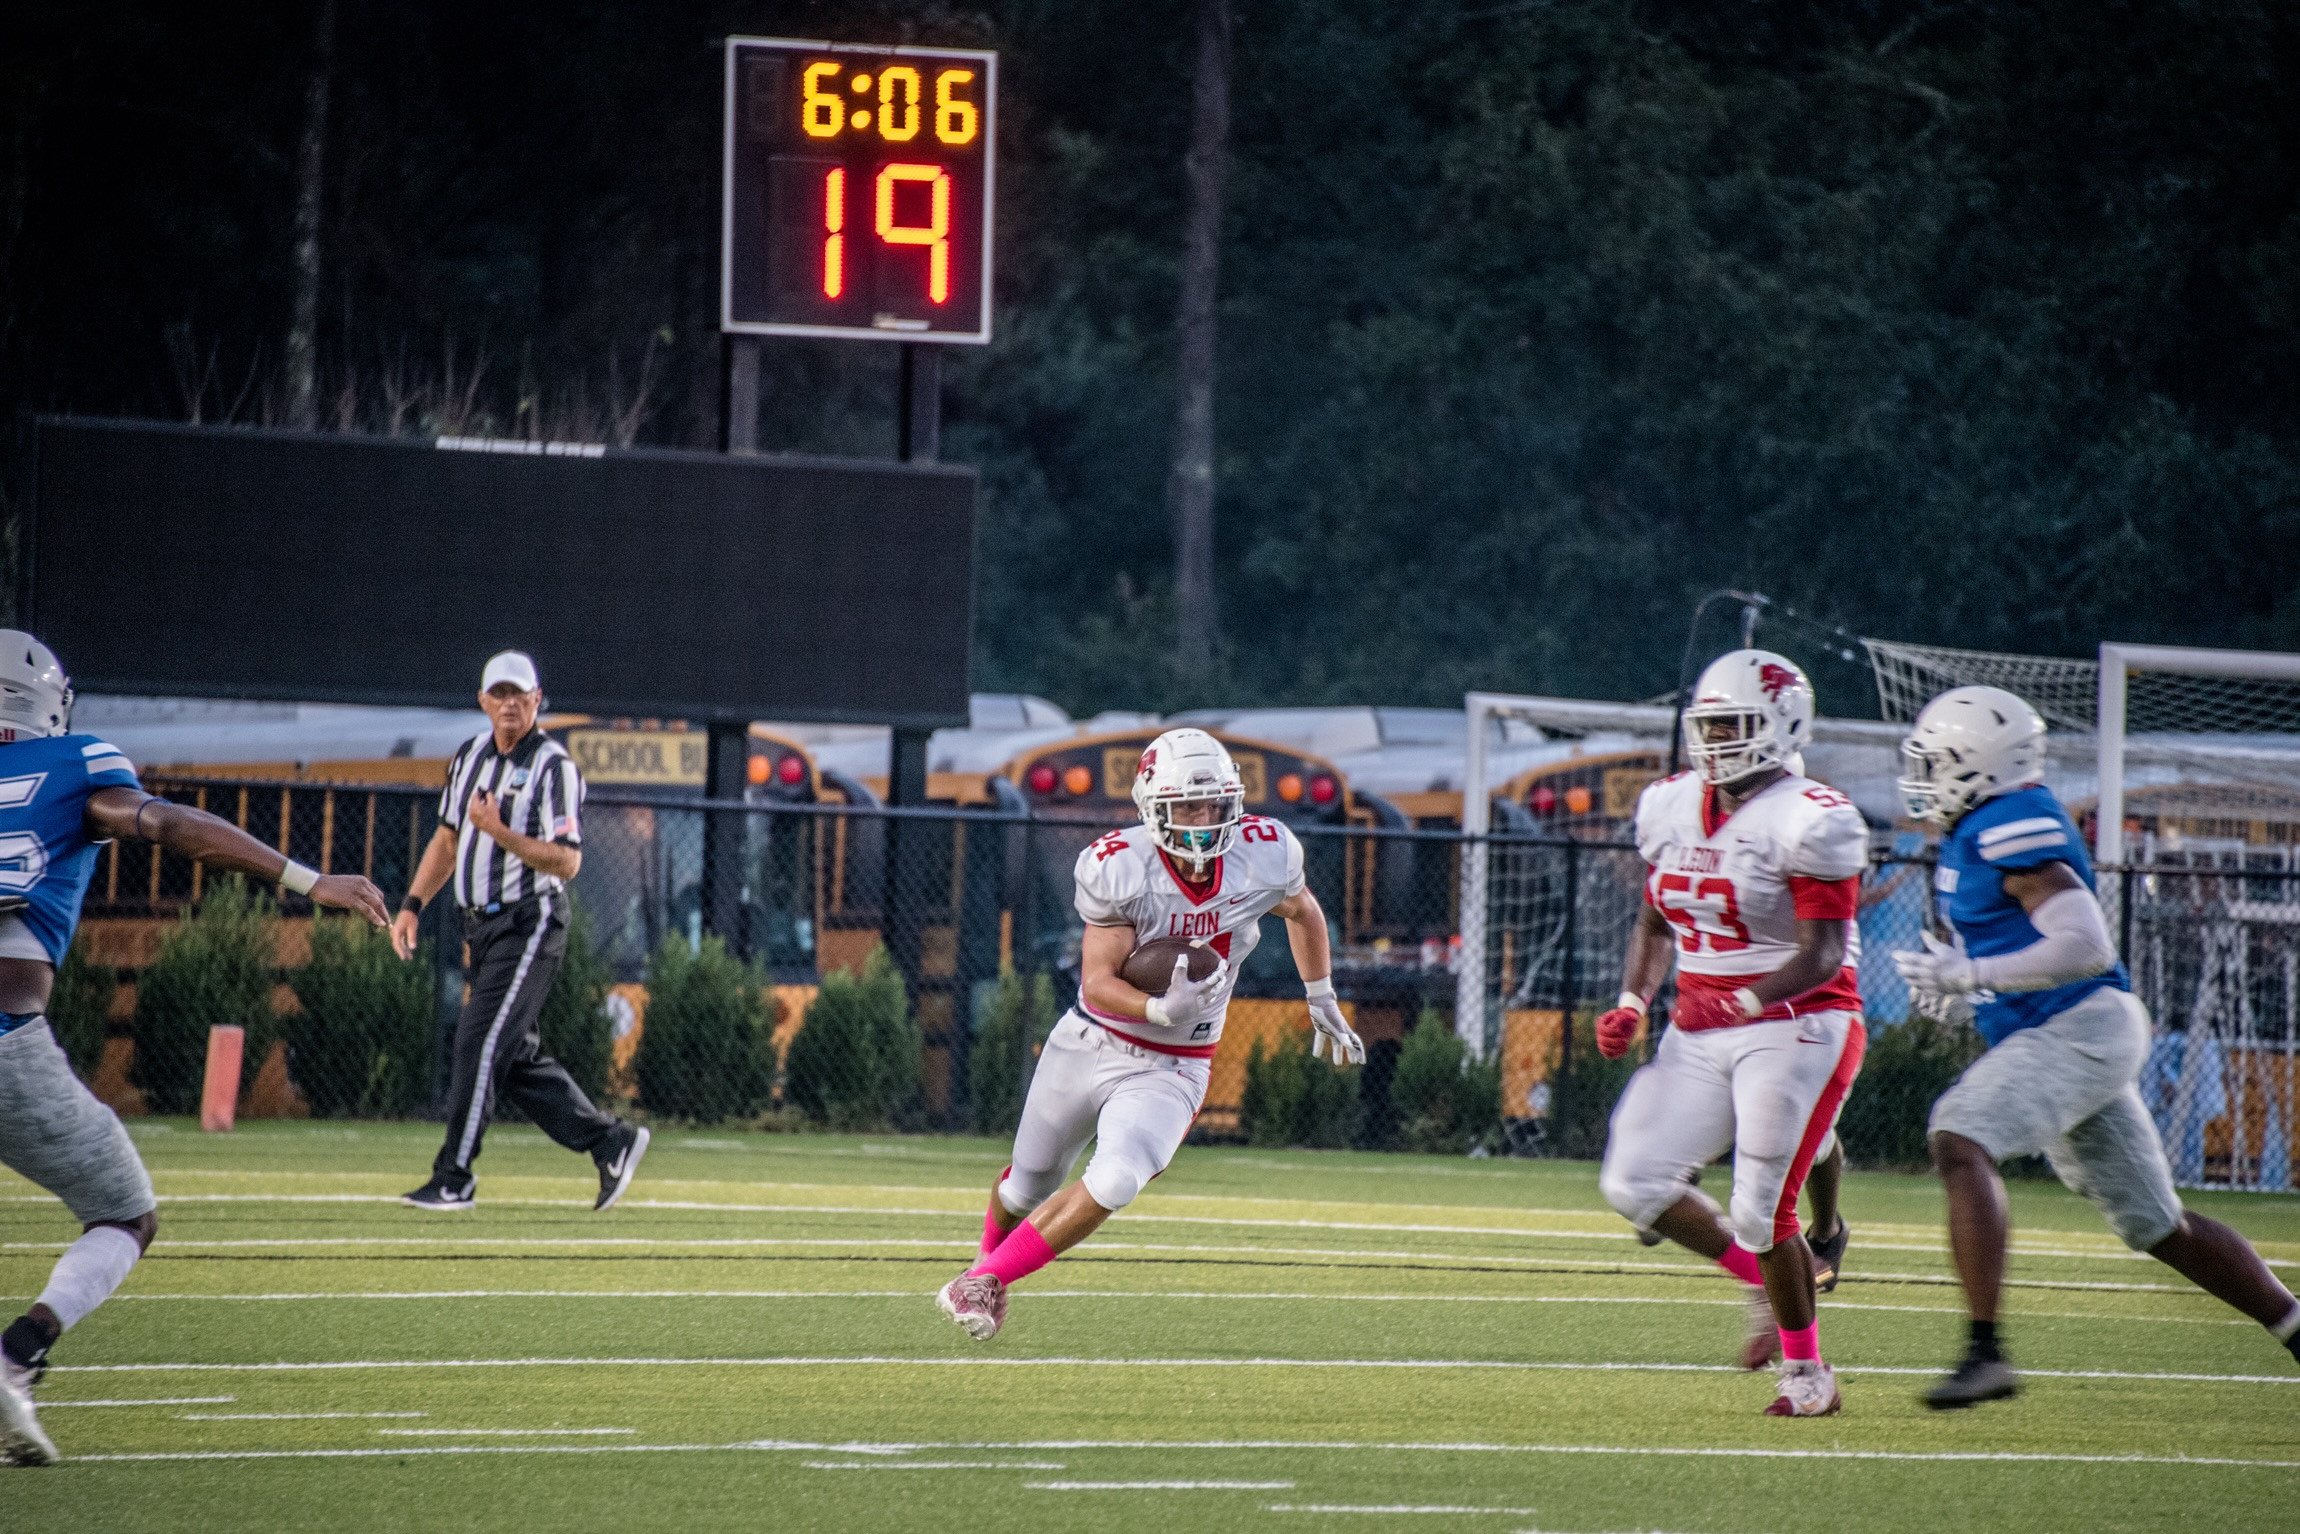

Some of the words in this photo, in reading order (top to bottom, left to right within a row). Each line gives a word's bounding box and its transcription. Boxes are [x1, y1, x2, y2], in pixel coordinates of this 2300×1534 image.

[803, 62, 978, 144] 6:06
[824, 163, 950, 304] 19
[575, 739, 668, 775] SCHOOL
[1169, 911, 1219, 936] LEON
[1658, 873, 1750, 953] 53
